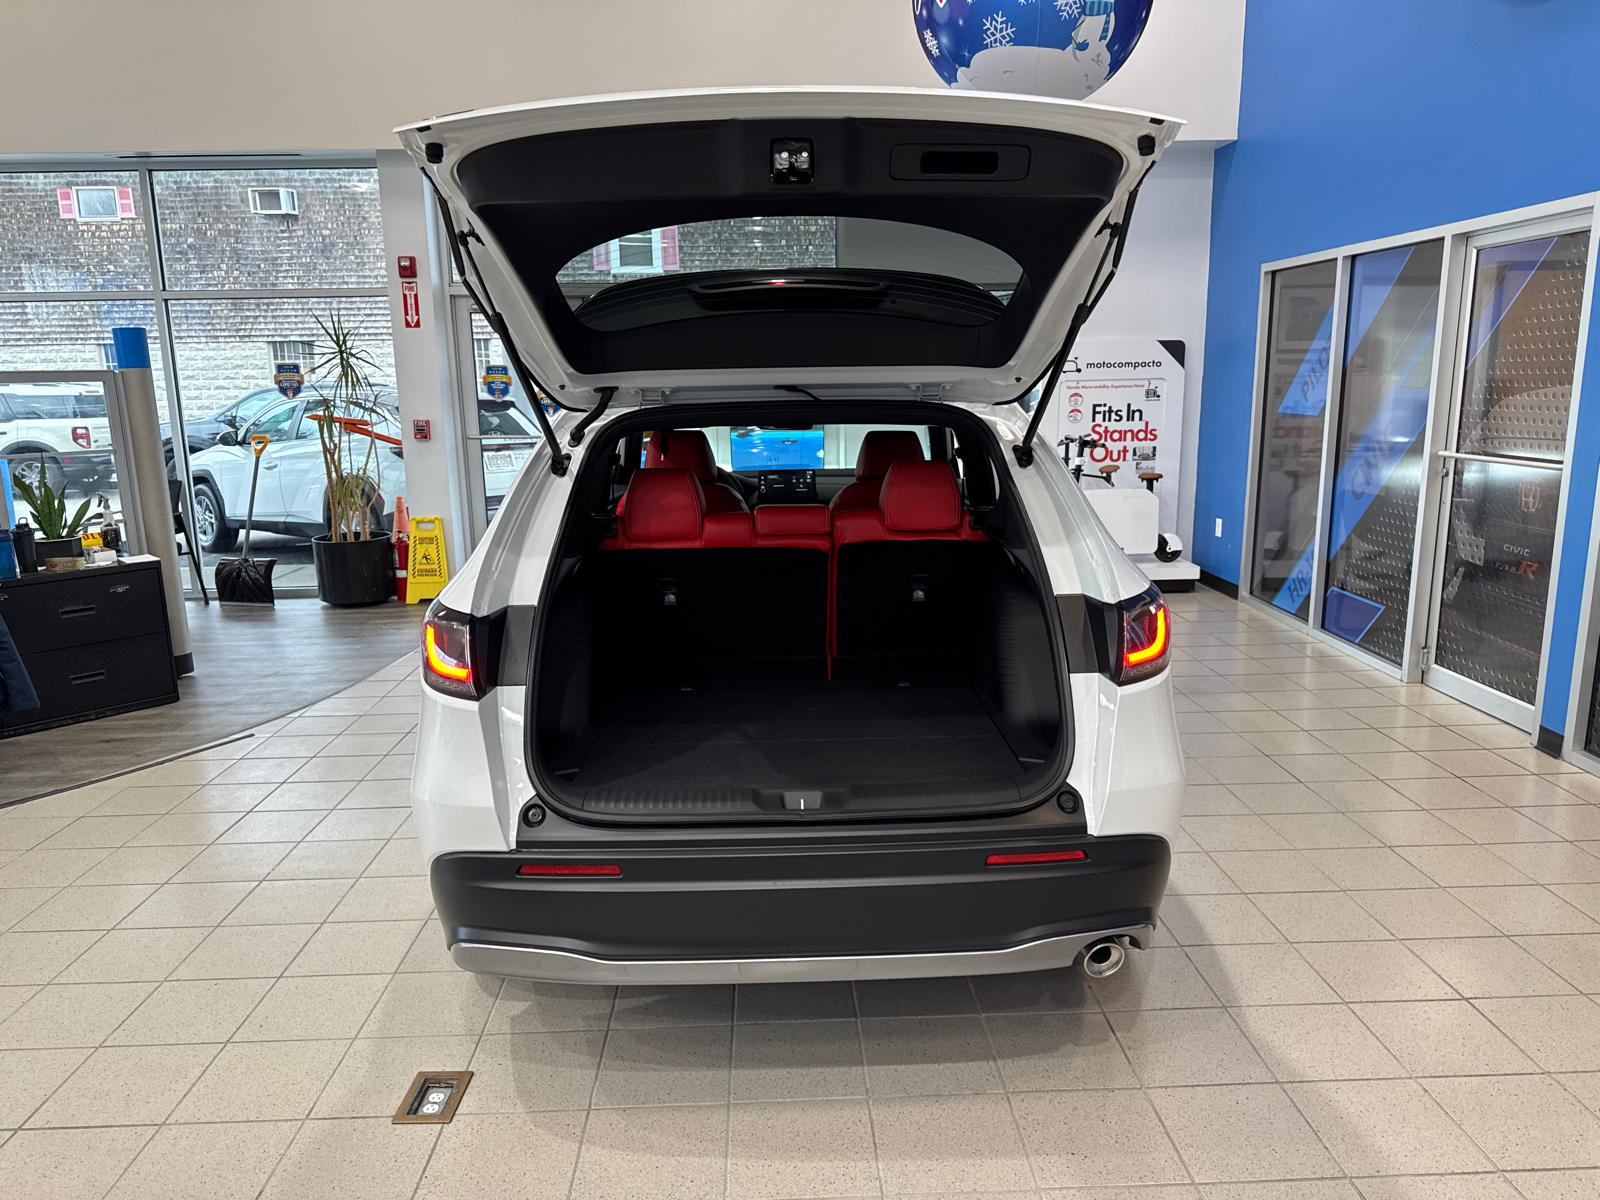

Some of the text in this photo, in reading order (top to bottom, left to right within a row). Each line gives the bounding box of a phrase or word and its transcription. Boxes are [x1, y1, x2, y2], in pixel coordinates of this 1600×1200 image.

[405, 285, 415, 293] FIRE
[1086, 360, 1162, 370] motocompacto
[1092, 402, 1124, 423] Fits
[1090, 421, 1158, 443] Stands
[1503, 544, 1531, 557] CIVIC
